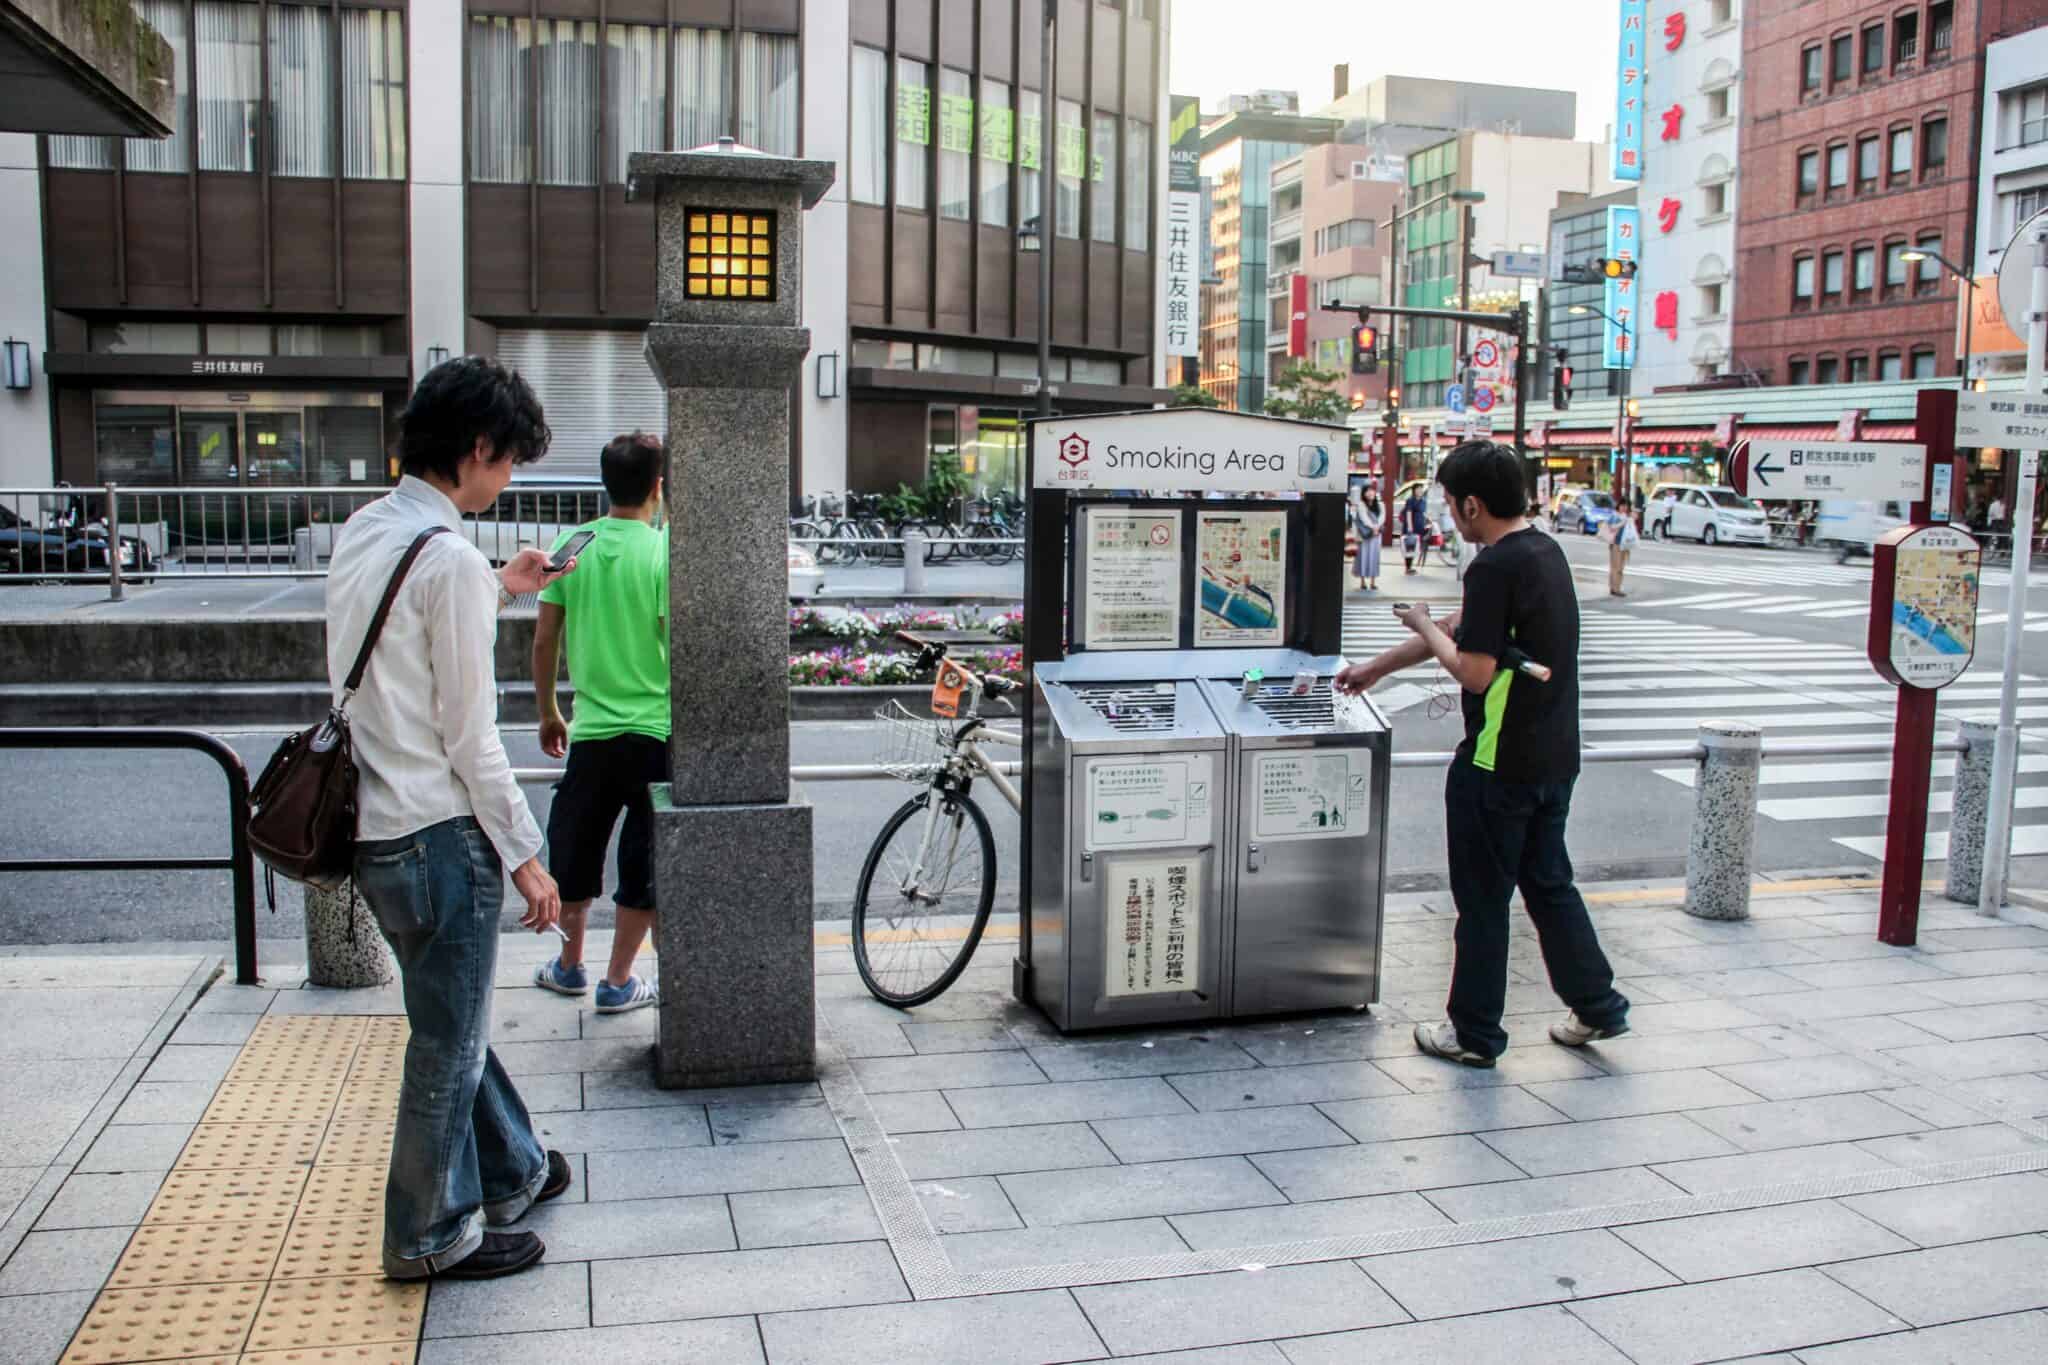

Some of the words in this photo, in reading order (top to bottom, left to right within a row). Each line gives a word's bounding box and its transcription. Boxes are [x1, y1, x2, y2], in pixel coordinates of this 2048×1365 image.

[1622, 0, 1641, 166] パーティー館
[1168, 202, 1190, 347] 三井住友銀行
[191, 361, 265, 375] 三井住友銀行
[1057, 469, 1089, 481] 台東区
[1106, 444, 1215, 474] Smoking
[1223, 449, 1285, 471] Area
[1166, 865, 1187, 984] 喫煙スポットをご利用の皆様へ
